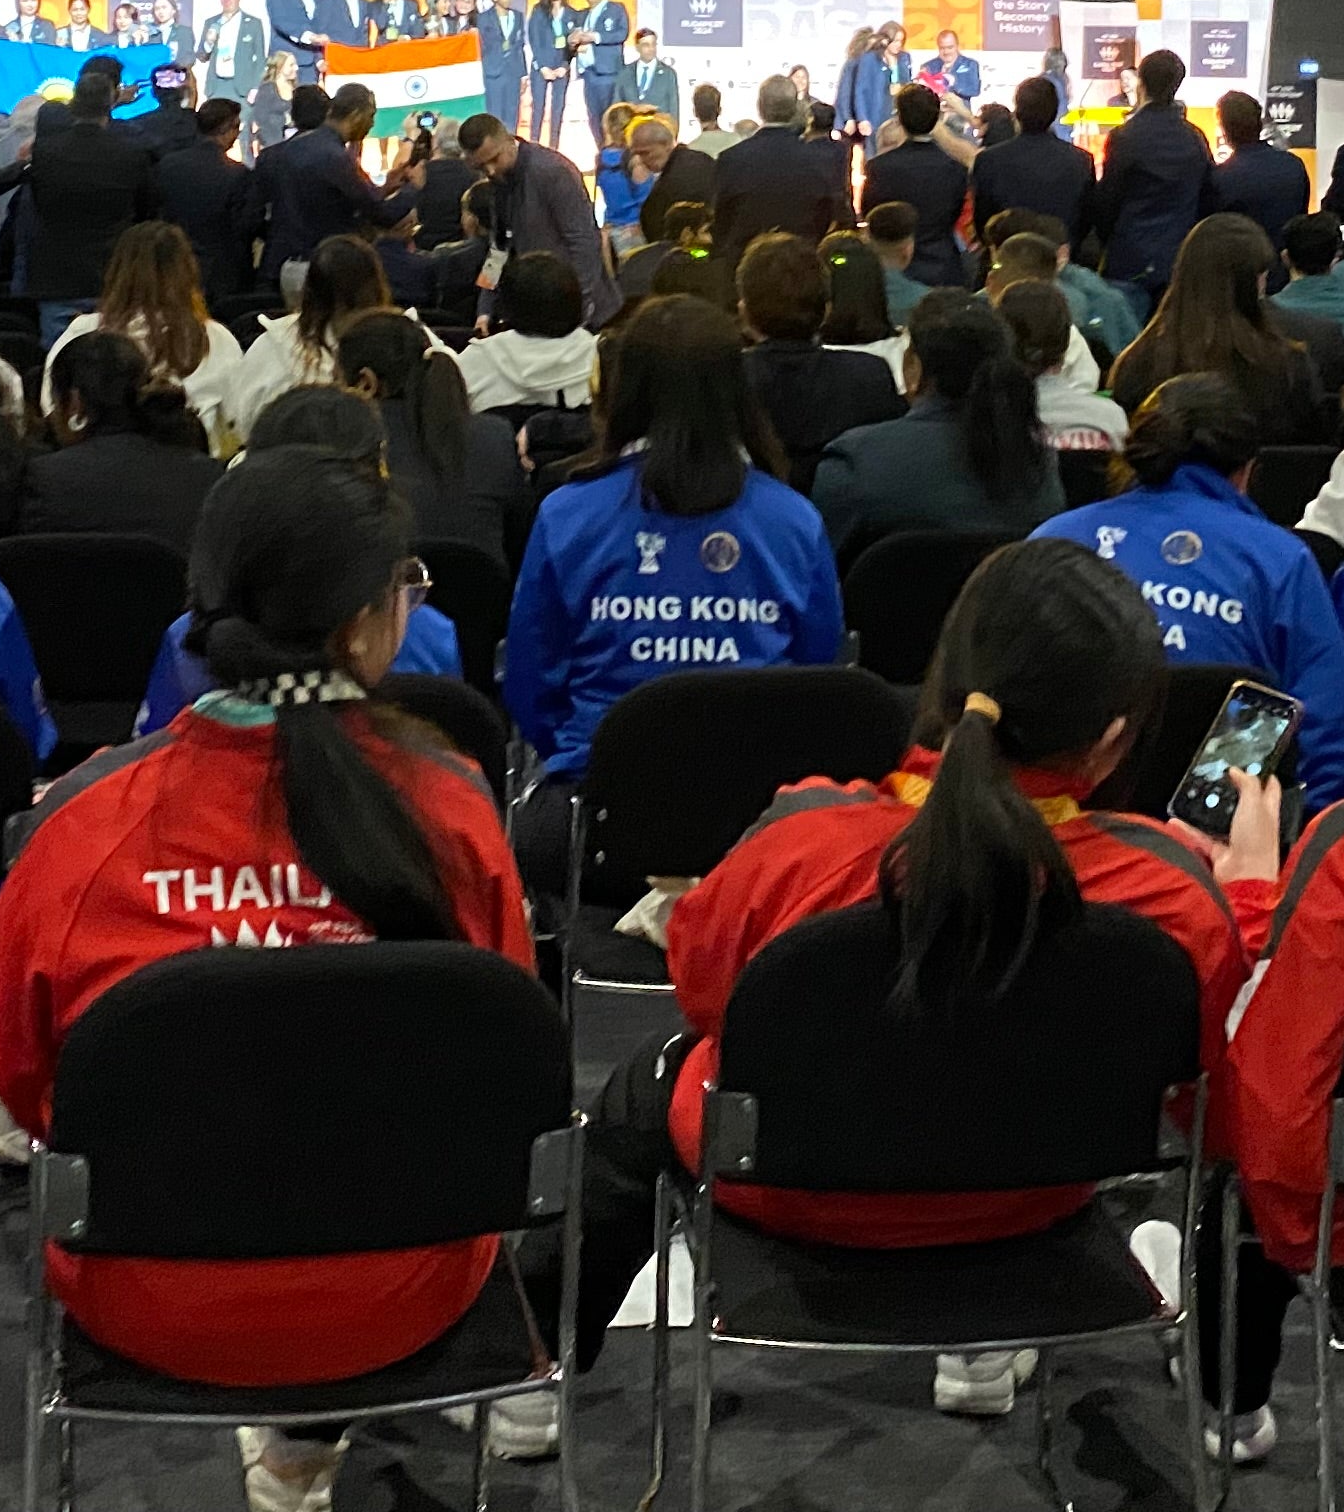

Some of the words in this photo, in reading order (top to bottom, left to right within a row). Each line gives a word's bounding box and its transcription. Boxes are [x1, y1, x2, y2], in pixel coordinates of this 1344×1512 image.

[993, 0, 1015, 11] the
[1016, 0, 1051, 12] Story
[994, 11, 1050, 23] Becomes
[999, 22, 1046, 35] History
[590, 596, 682, 621] HONG
[690, 596, 781, 624] KONG
[1141, 580, 1244, 624] KONG
[630, 636, 740, 662] CHINA
[142, 863, 332, 915] THAIL
